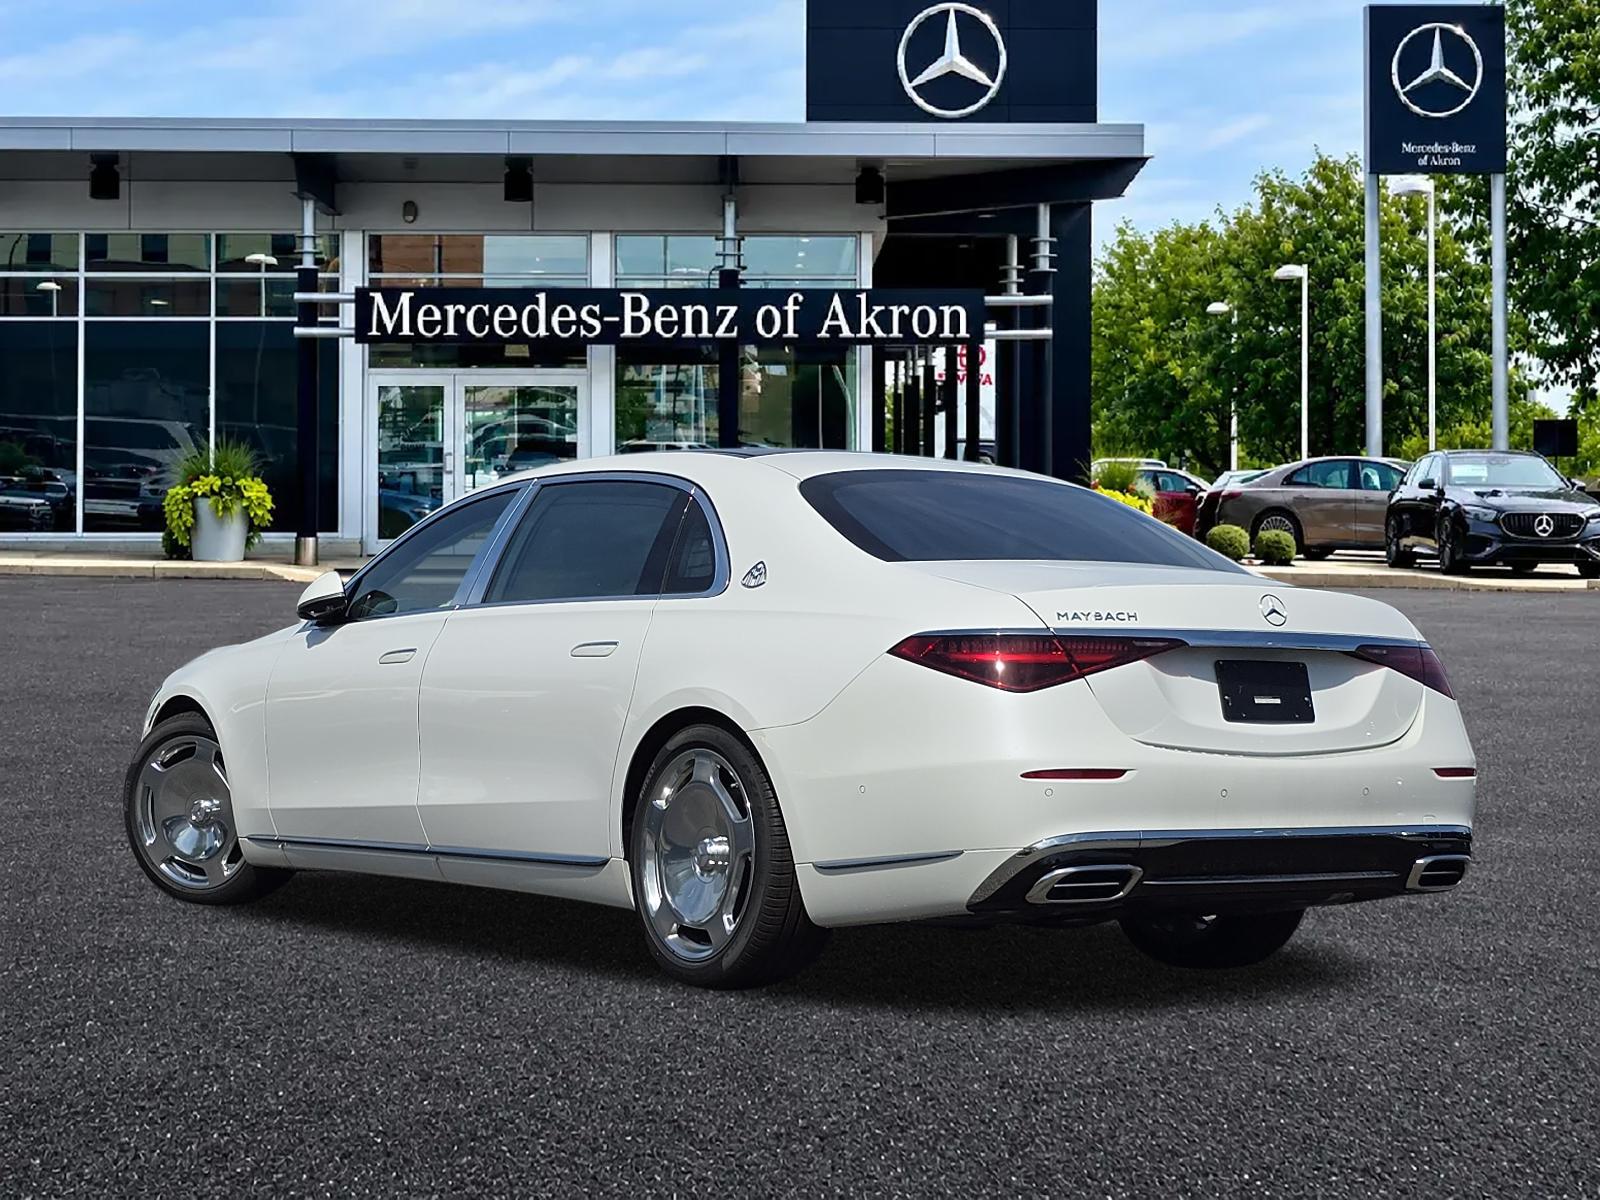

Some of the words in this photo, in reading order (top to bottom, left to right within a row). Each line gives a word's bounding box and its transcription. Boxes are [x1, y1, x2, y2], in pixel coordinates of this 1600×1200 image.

[1401, 141, 1476, 153] Mercedes-Benz
[1417, 154, 1429, 166] of
[1430, 154, 1461, 166] Akron
[367, 291, 738, 338] Mercedes-Benz
[755, 291, 804, 338] of
[816, 290, 971, 338] Akron
[1056, 611, 1138, 622] MAYBACH
